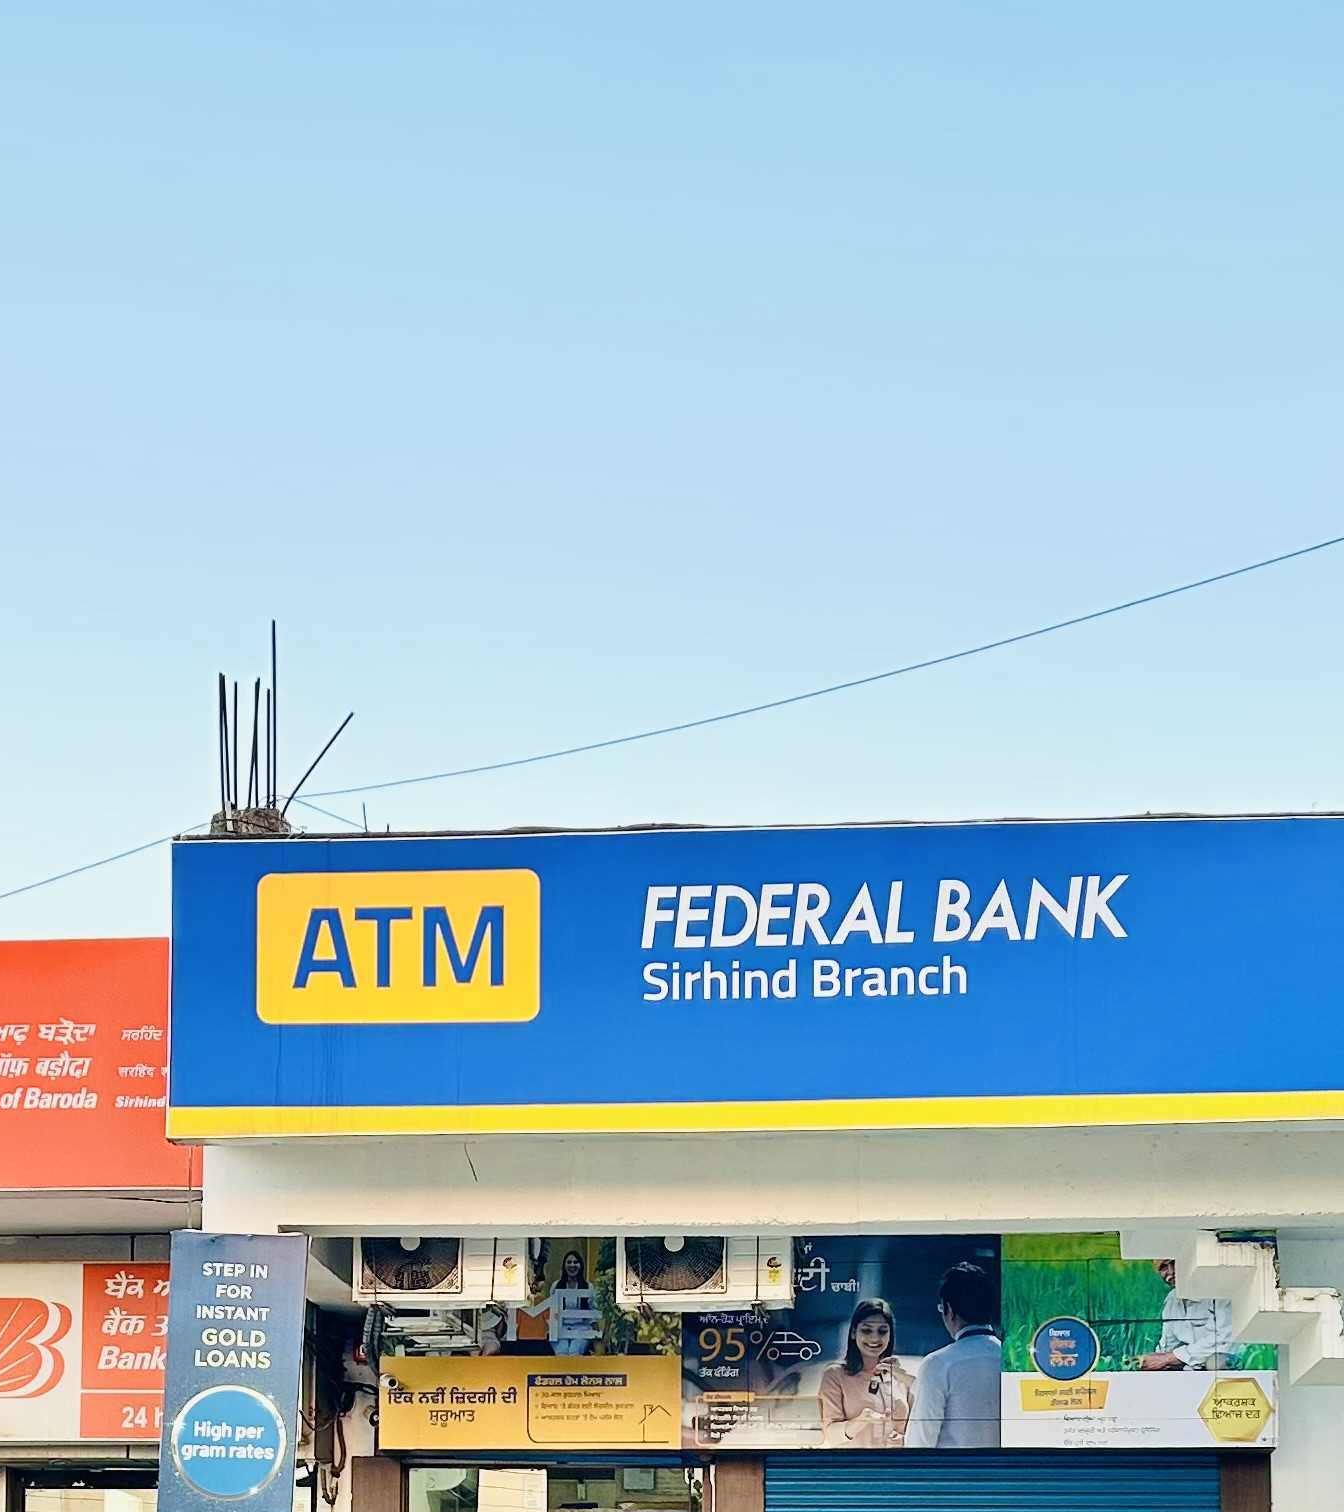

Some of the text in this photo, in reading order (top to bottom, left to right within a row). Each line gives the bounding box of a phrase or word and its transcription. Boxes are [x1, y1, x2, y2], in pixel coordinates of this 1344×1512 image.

[640, 874, 1130, 949] FEDERAL BANK
[292, 904, 505, 988] ATM
[642, 955, 967, 1001] Sirhind Branch
[35, 1051, 93, 1080] बड़ौदा
[0, 1087, 23, 1109] of
[24, 1087, 98, 1109] Baroda
[202, 1262, 268, 1279] STEP IN
[216, 1284, 252, 1299] FOR
[101, 1306, 147, 1336] बैंक
[196, 1305, 270, 1321] INSTANT
[202, 1328, 265, 1347] GOLD
[98, 1346, 167, 1370] Bank
[194, 1349, 271, 1369] LOANS
[501, 1387, 518, 1404] ਦੀ
[121, 1406, 148, 1428] 24
[194, 1420, 264, 1441] High per
[181, 1444, 274, 1460] gram rates
